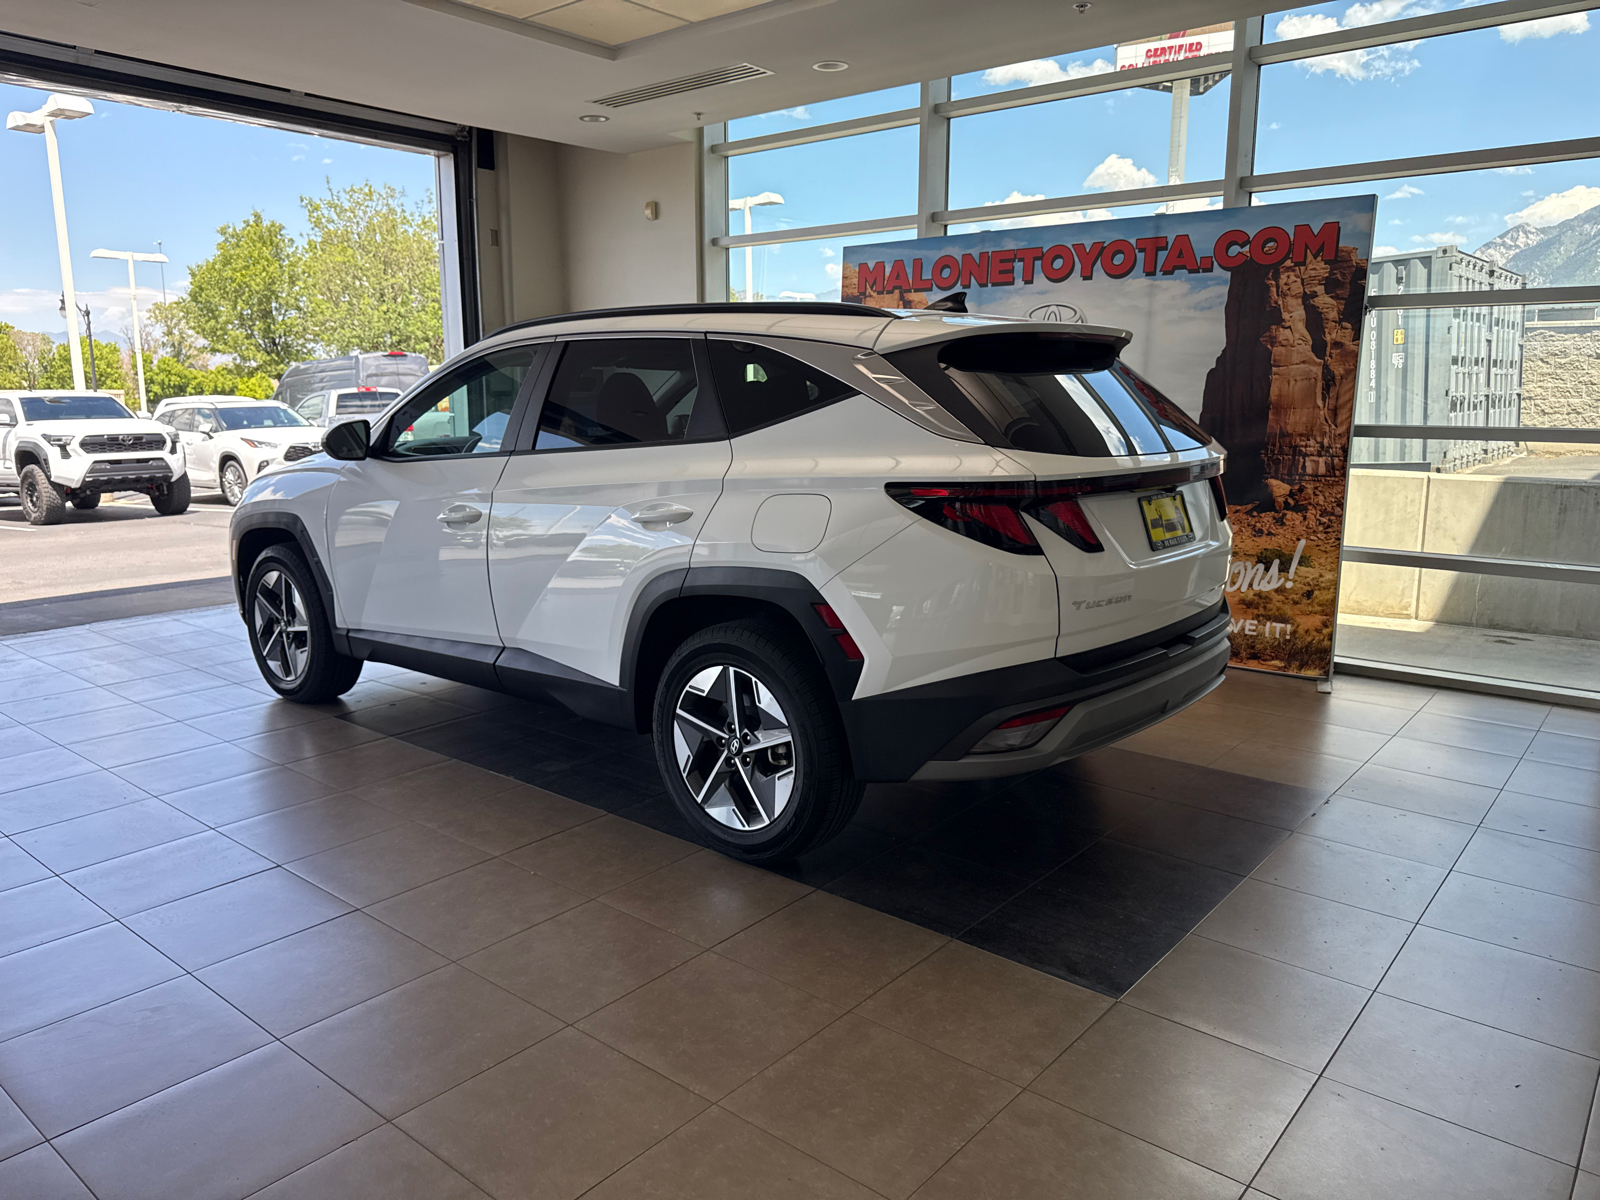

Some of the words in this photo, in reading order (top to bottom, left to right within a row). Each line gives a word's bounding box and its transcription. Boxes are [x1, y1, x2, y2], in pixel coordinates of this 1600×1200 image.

[1145, 41, 1203, 59] CERTIFIED
[857, 221, 1340, 294] MALONETOYOTA.COM
[1265, 622, 1292, 640] IT!
